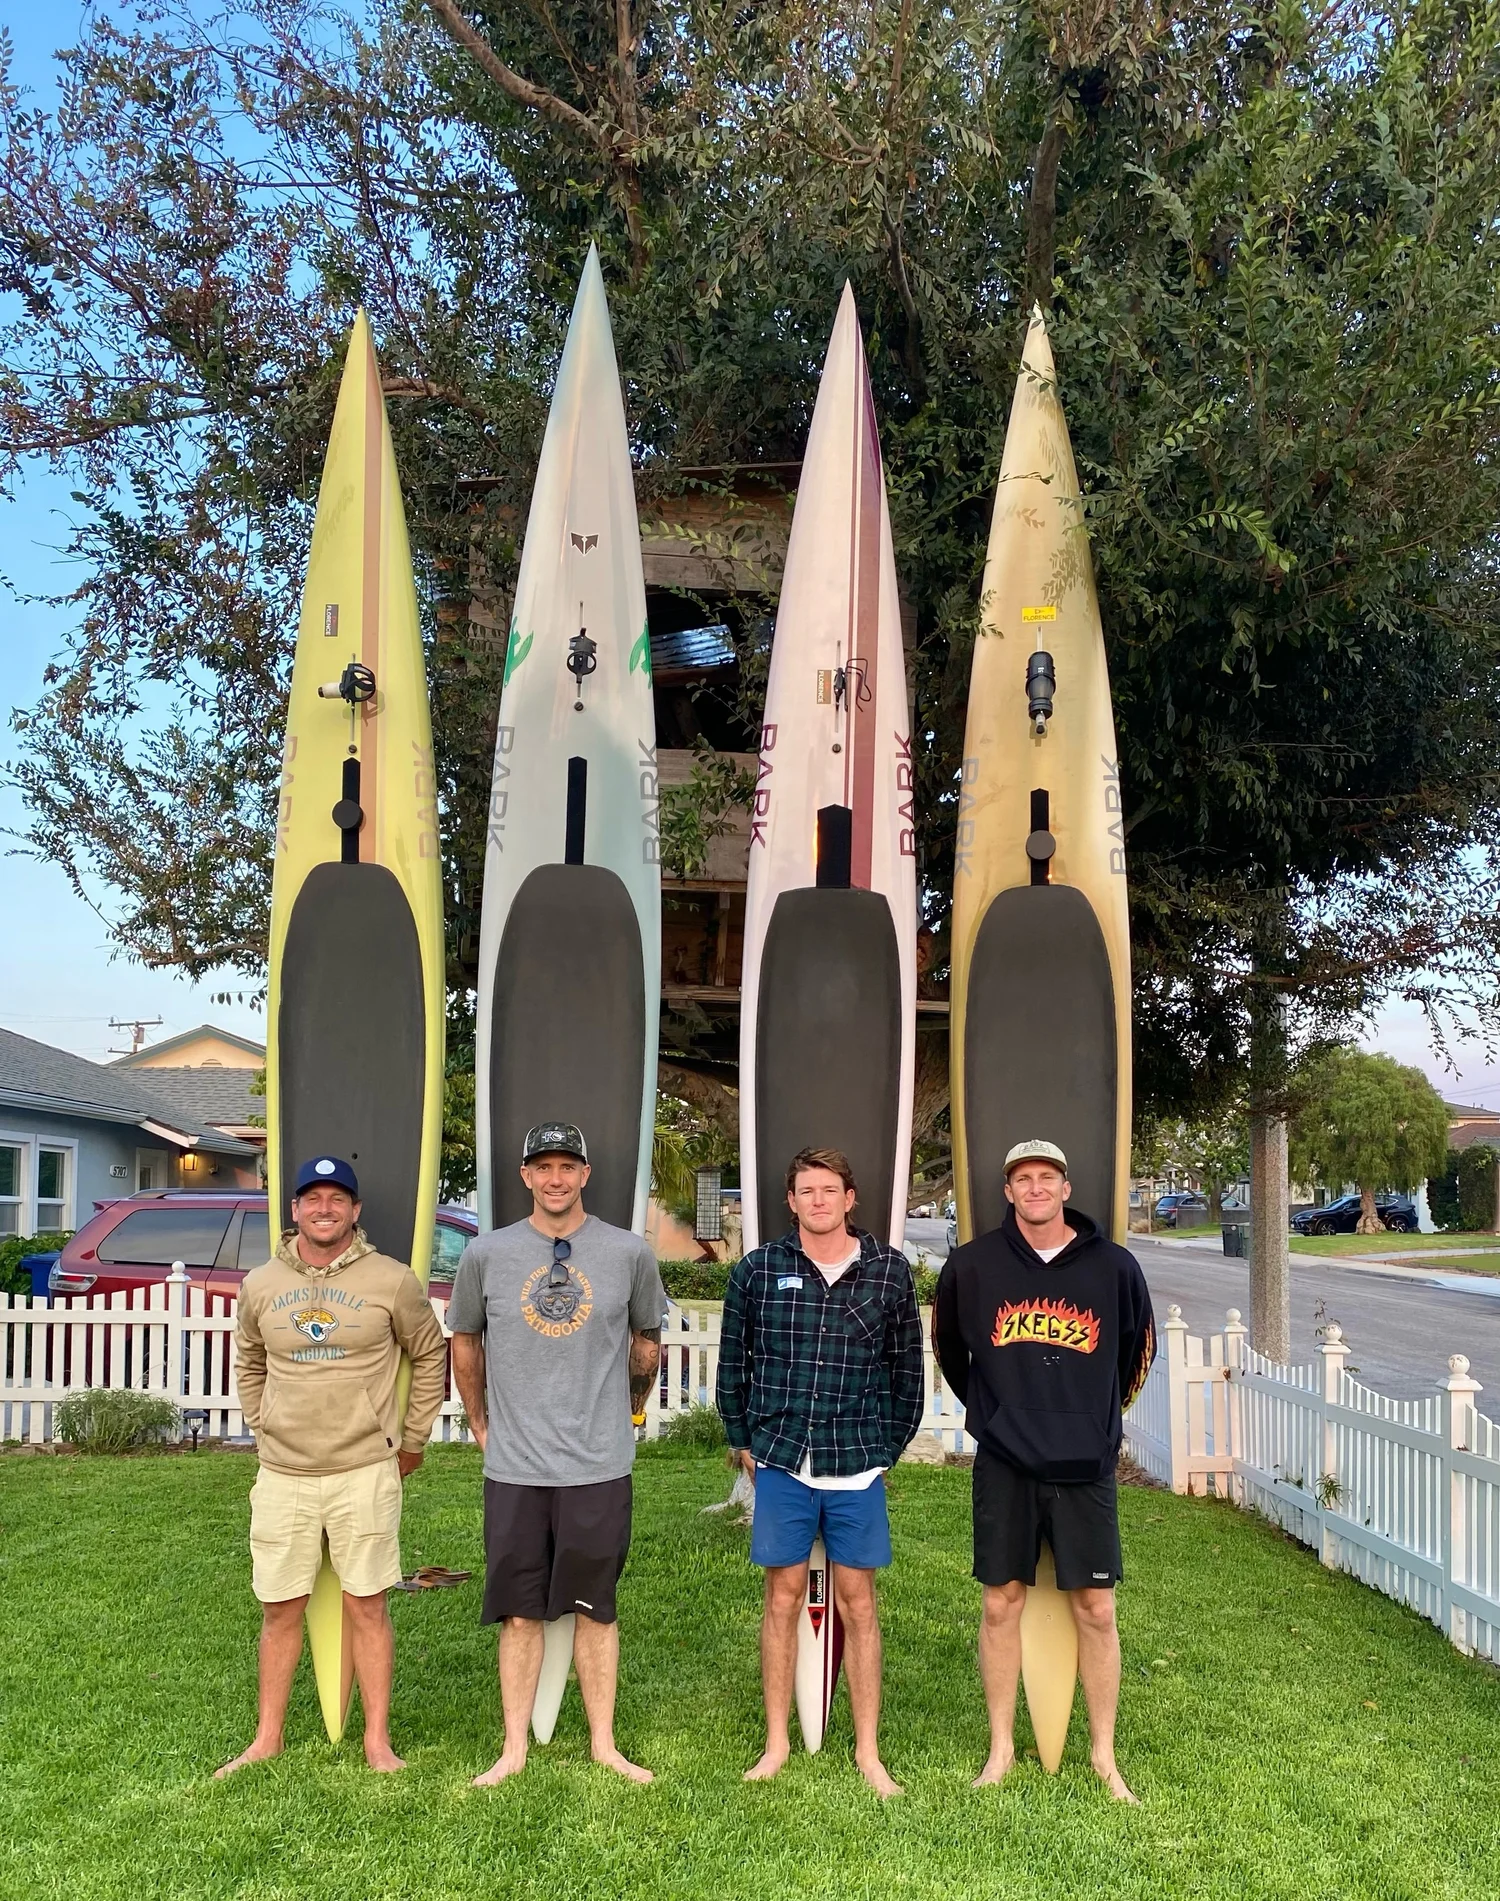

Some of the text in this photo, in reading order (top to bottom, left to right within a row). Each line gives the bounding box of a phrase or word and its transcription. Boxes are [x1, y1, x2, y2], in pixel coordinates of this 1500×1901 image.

[487, 726, 515, 853] BARK
[638, 738, 661, 865] BARK
[751, 724, 778, 849] BARK
[894, 730, 916, 856] BARK
[955, 758, 979, 878] BARK
[1100, 753, 1127, 875] BARK
[271, 1286, 367, 1312] JACKSONVILLE
[521, 1303, 593, 1337] PATAGONIA
[529, 1265, 549, 1281] FISH
[1003, 1311, 1090, 1345] SKEGSS
[291, 1346, 347, 1362] JAGUARS
